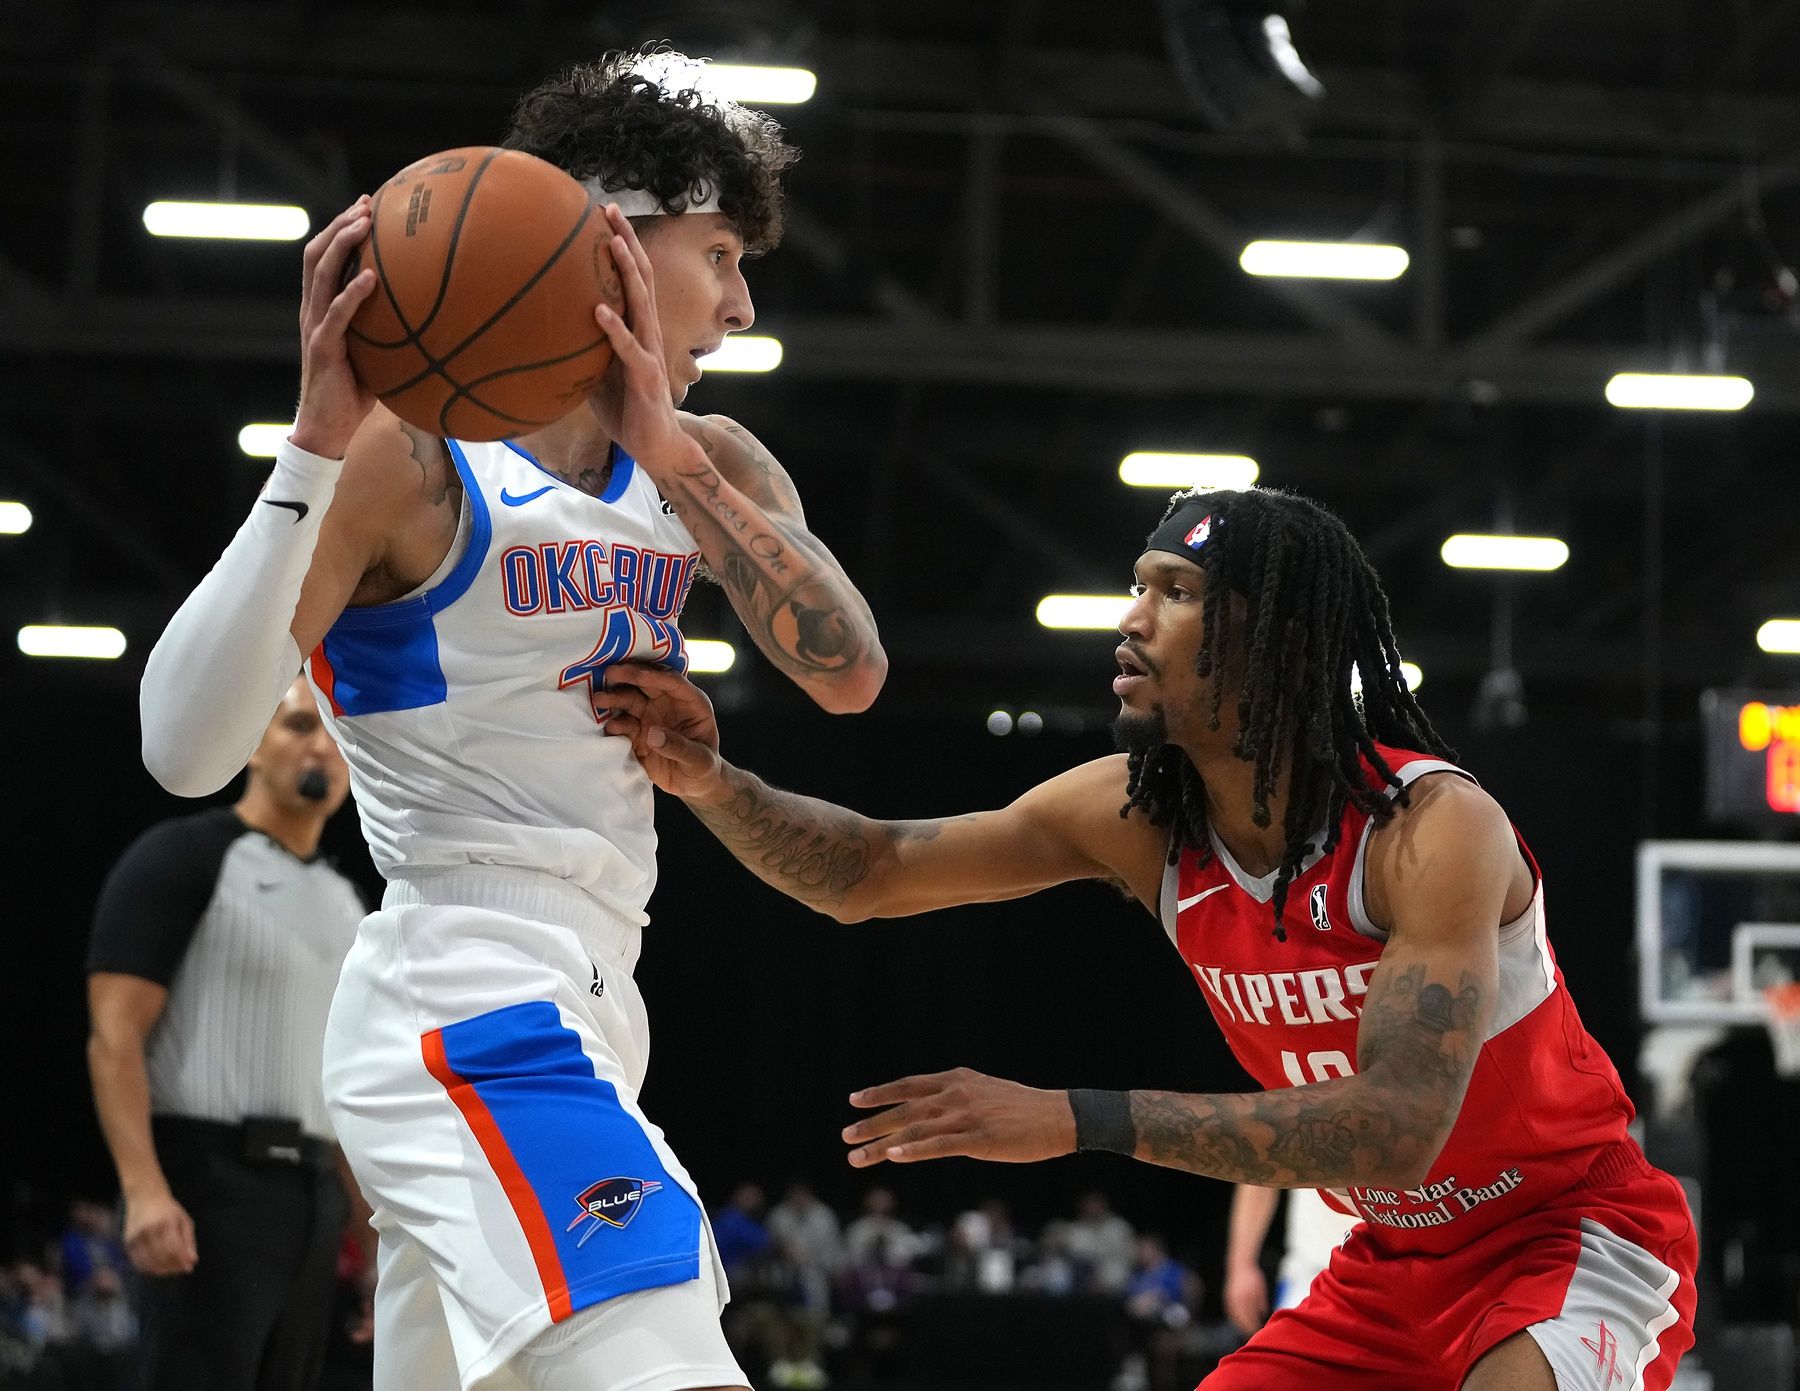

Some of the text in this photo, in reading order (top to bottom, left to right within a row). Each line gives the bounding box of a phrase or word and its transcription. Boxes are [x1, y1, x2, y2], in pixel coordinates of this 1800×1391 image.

[501, 540, 616, 616] OKC
[588, 1190, 641, 1213] BLUE
[1354, 1187, 1401, 1206] Lone
[1361, 1170, 1524, 1229] National Bank
